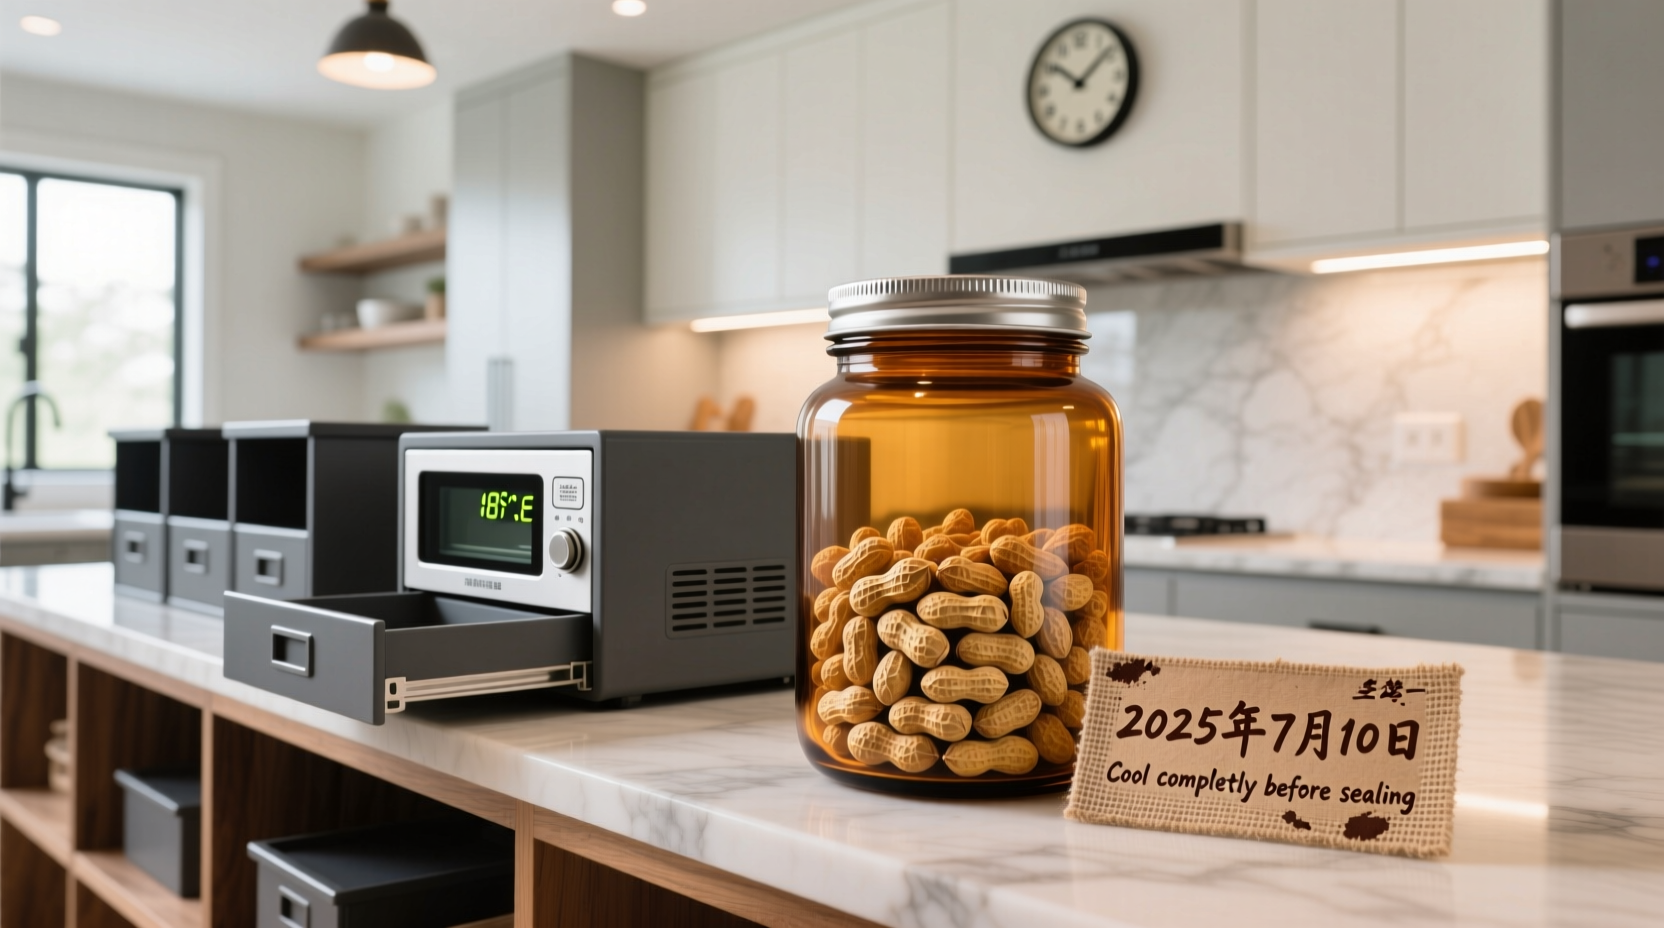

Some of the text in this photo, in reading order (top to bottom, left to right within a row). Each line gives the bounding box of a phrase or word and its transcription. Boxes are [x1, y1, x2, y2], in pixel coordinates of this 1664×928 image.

[1115, 700, 1420, 761] 2025年7月10日
[1106, 760, 1416, 816] Cool completly before sealing
